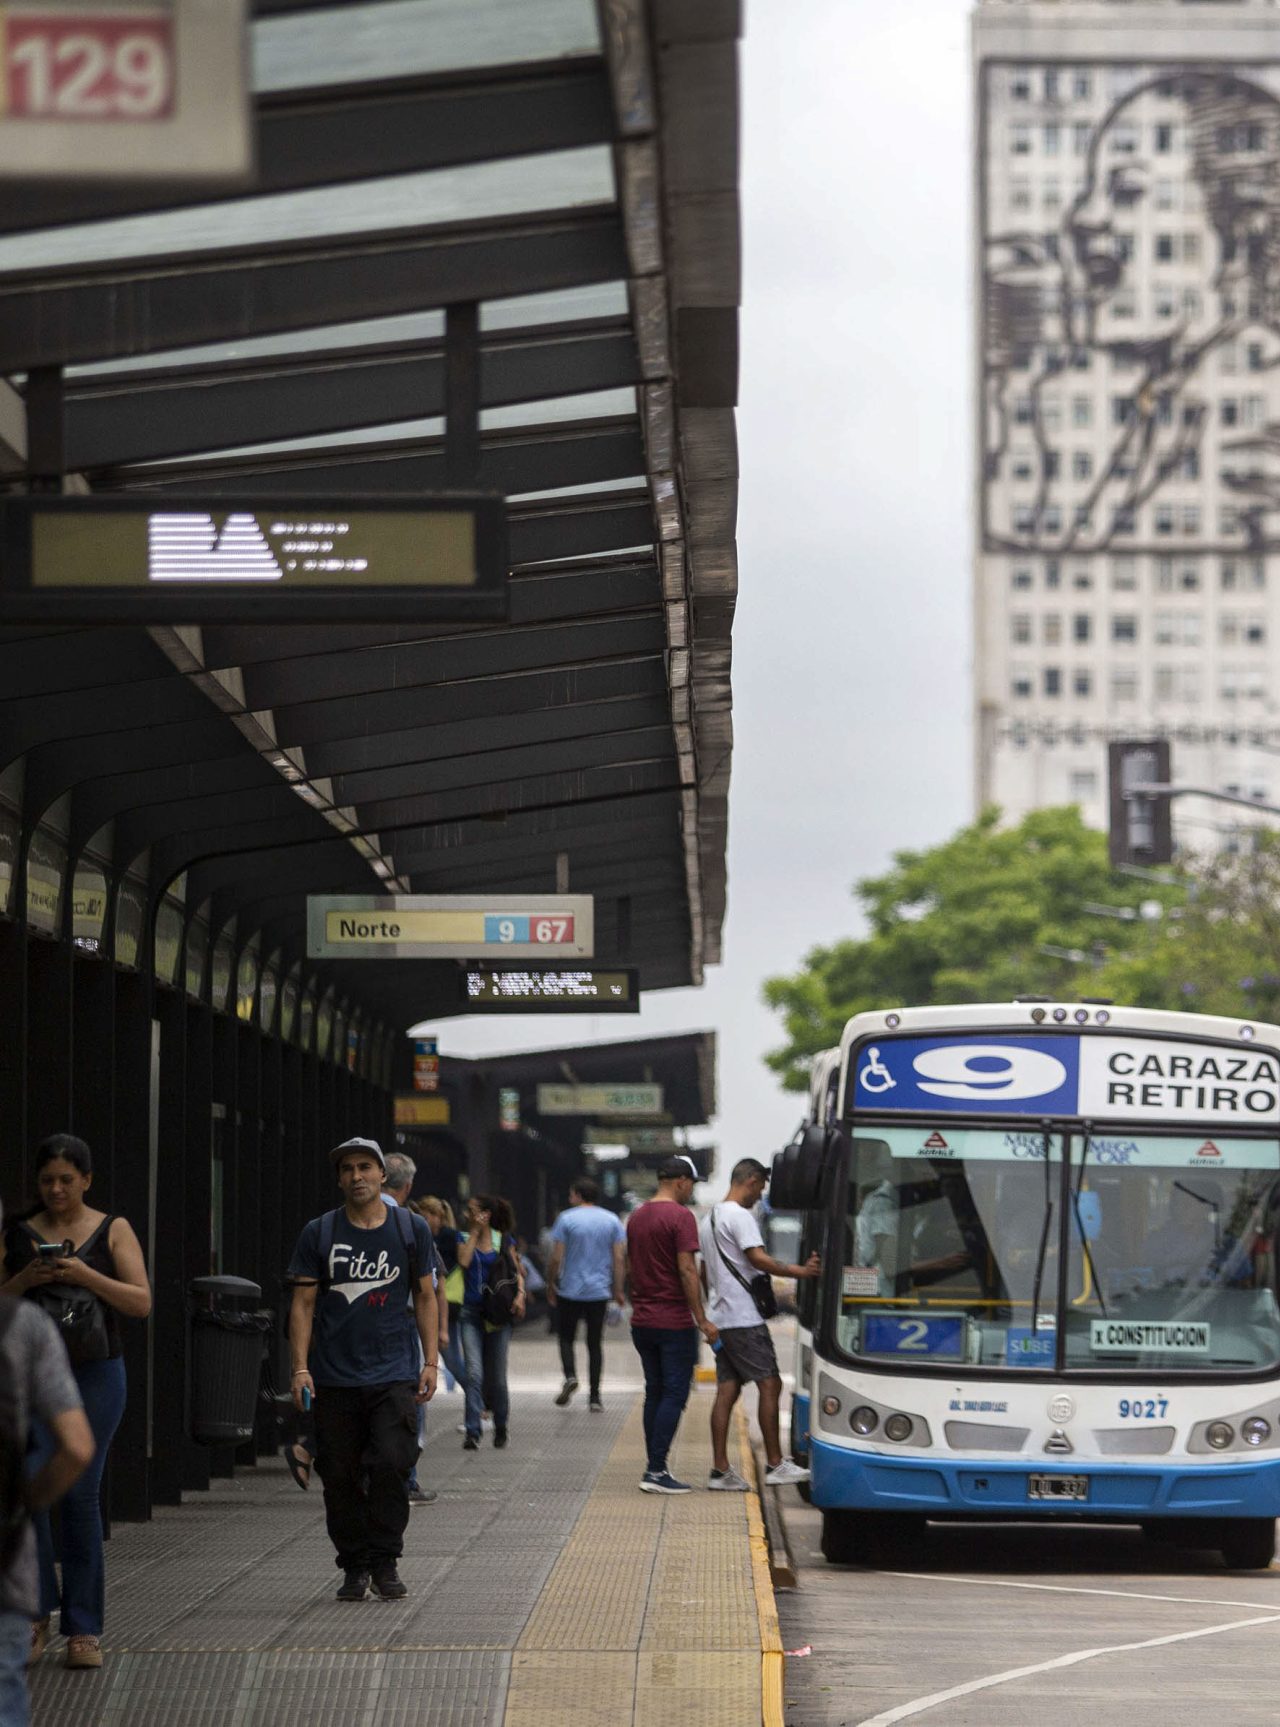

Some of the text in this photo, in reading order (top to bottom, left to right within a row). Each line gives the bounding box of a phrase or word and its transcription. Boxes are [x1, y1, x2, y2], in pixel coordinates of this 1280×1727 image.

[12, 33, 168, 115] 129
[339, 919, 568, 943] Norte 9 67
[912, 1044, 1067, 1100] 9
[1108, 1052, 1278, 1084] CARAZA
[1107, 1081, 1277, 1113] RETIRO
[328, 1243, 400, 1279] Fitch
[896, 1319, 929, 1350] 2
[1107, 1325, 1207, 1347] CONSTITUCION
[1118, 1399, 1170, 1419] 9027
